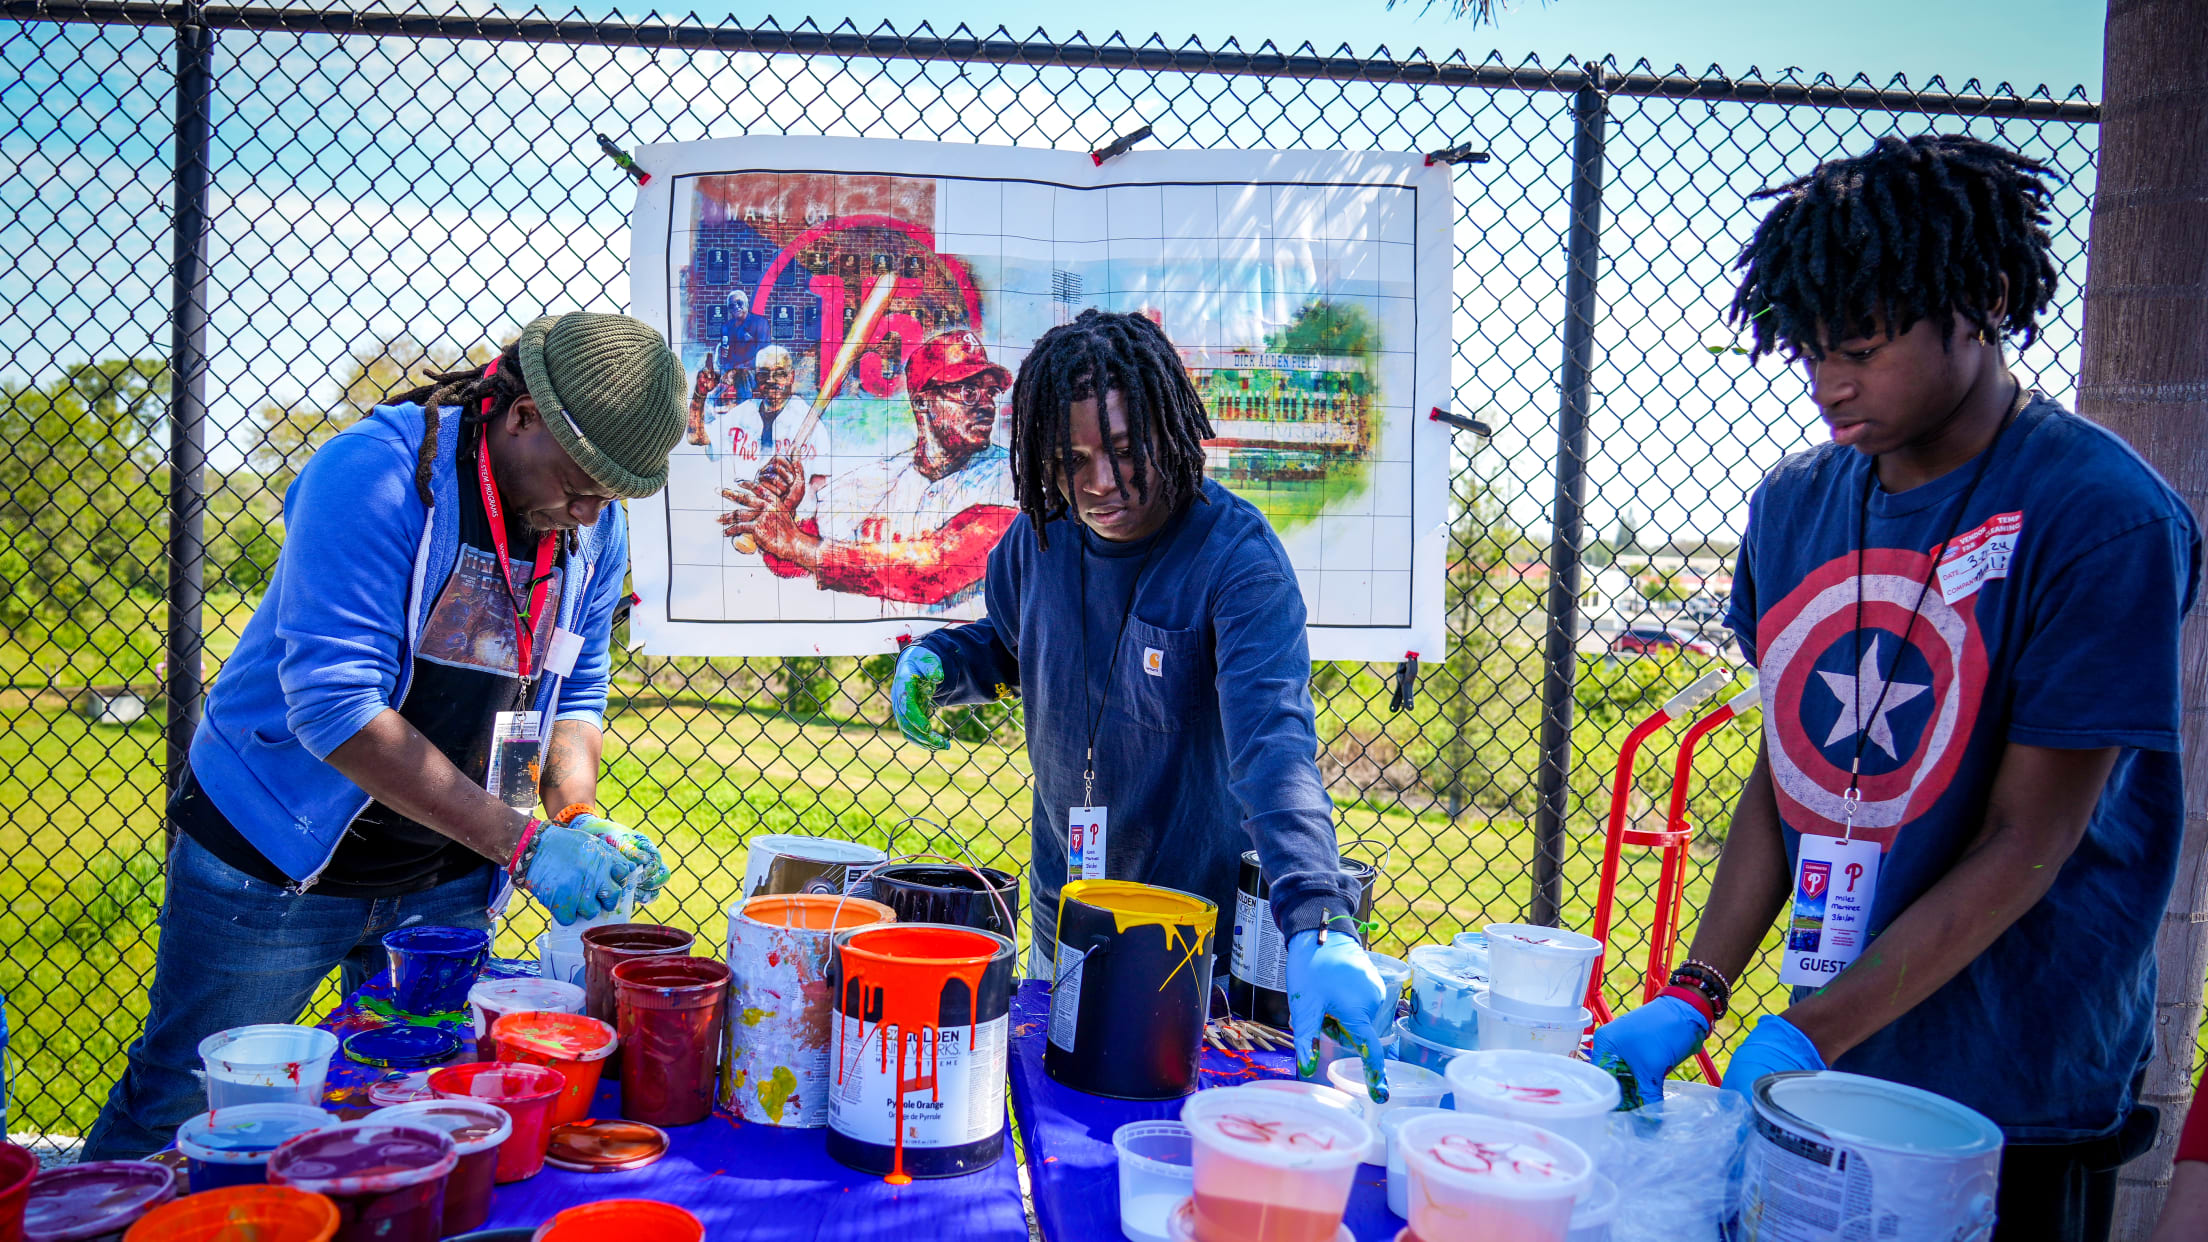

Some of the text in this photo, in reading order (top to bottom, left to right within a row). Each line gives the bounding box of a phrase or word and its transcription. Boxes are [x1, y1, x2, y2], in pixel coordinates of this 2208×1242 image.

[1234, 354, 1255, 367] DICK
[1259, 354, 1289, 368] ALLEN
[481, 465, 490, 482] STEM
[484, 483, 499, 518] PROGRAMS
[1943, 570, 1959, 580] DATE
[1799, 957, 1846, 974] GUEST
[887, 1098, 944, 1110] Pyole Orange
[888, 1111, 941, 1121] Orge de Pyrrole
